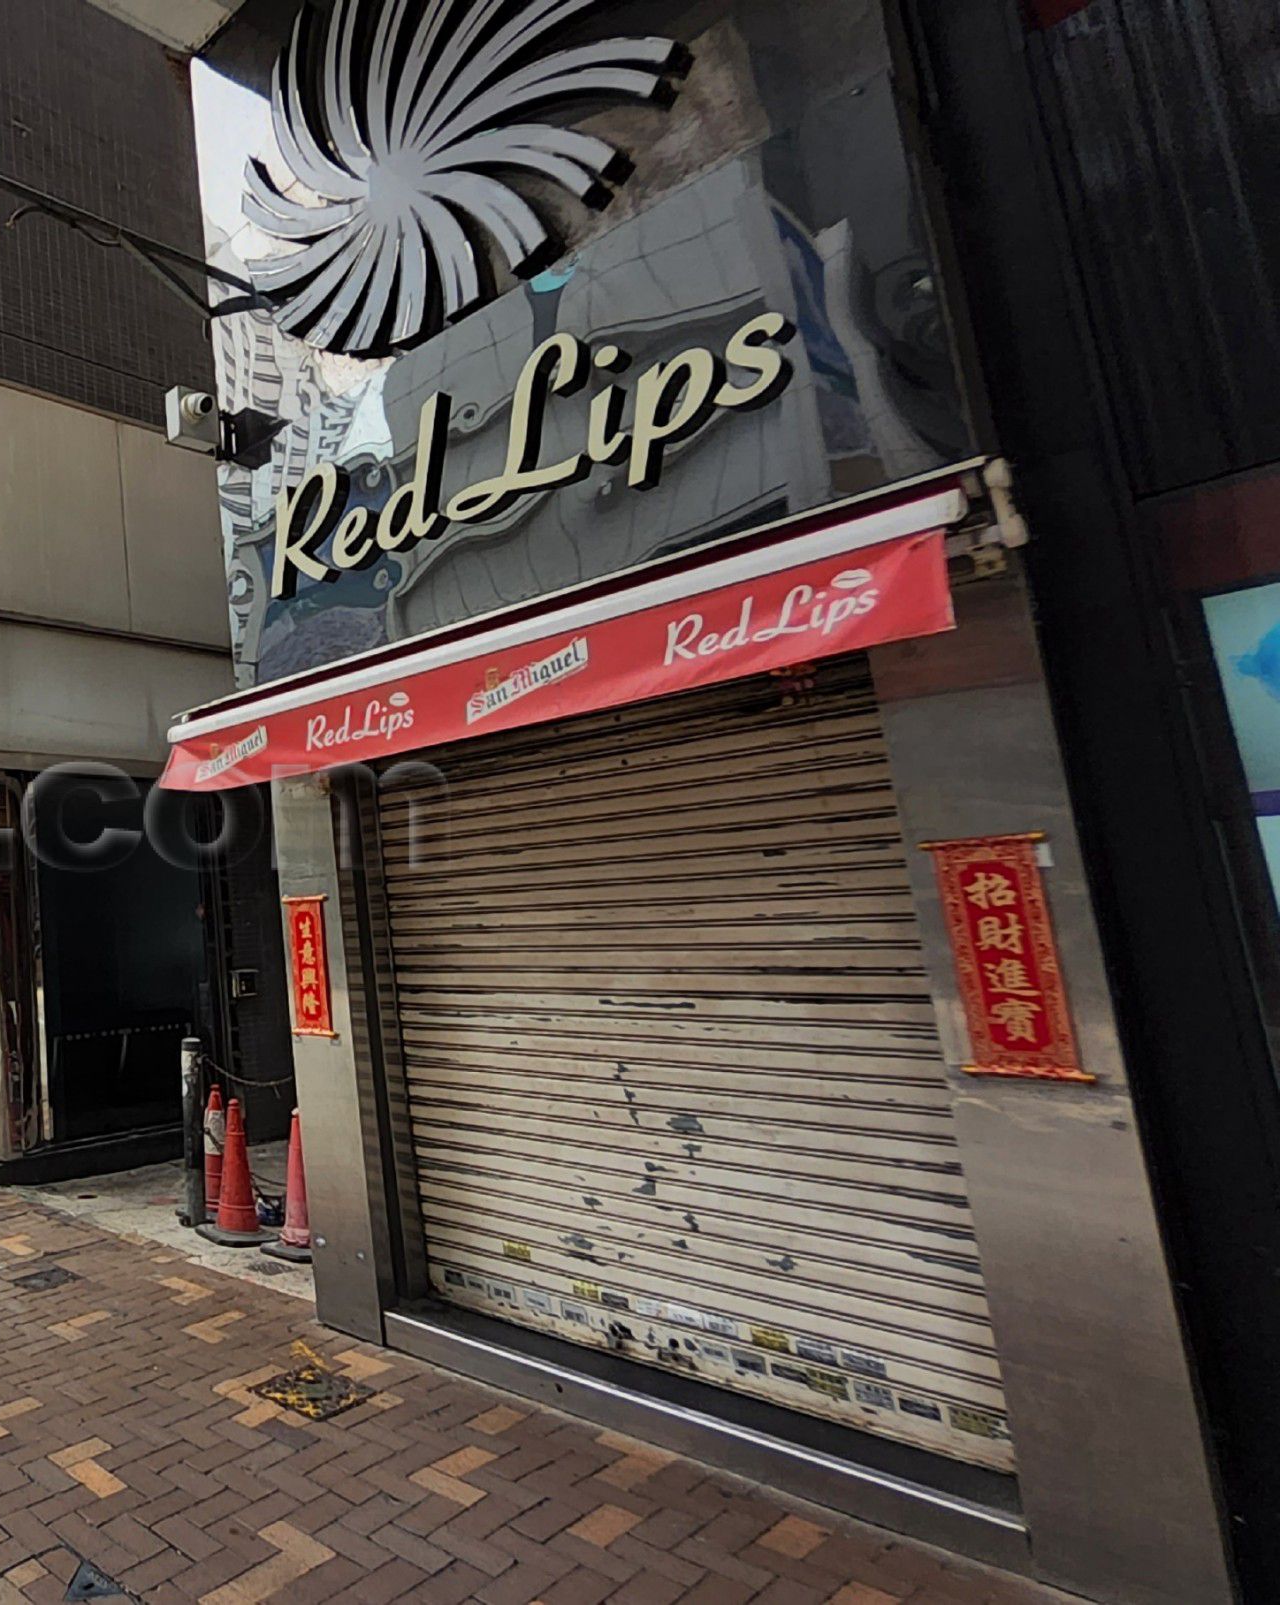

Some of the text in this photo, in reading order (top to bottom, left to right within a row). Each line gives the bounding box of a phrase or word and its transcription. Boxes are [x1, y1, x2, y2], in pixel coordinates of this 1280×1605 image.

[271, 311, 797, 600] Red Lips
[663, 585, 879, 666] Red Lips
[470, 640, 581, 716] San Miguel
[198, 725, 265, 779] San Miguel
[306, 700, 414, 751] Red Lips
